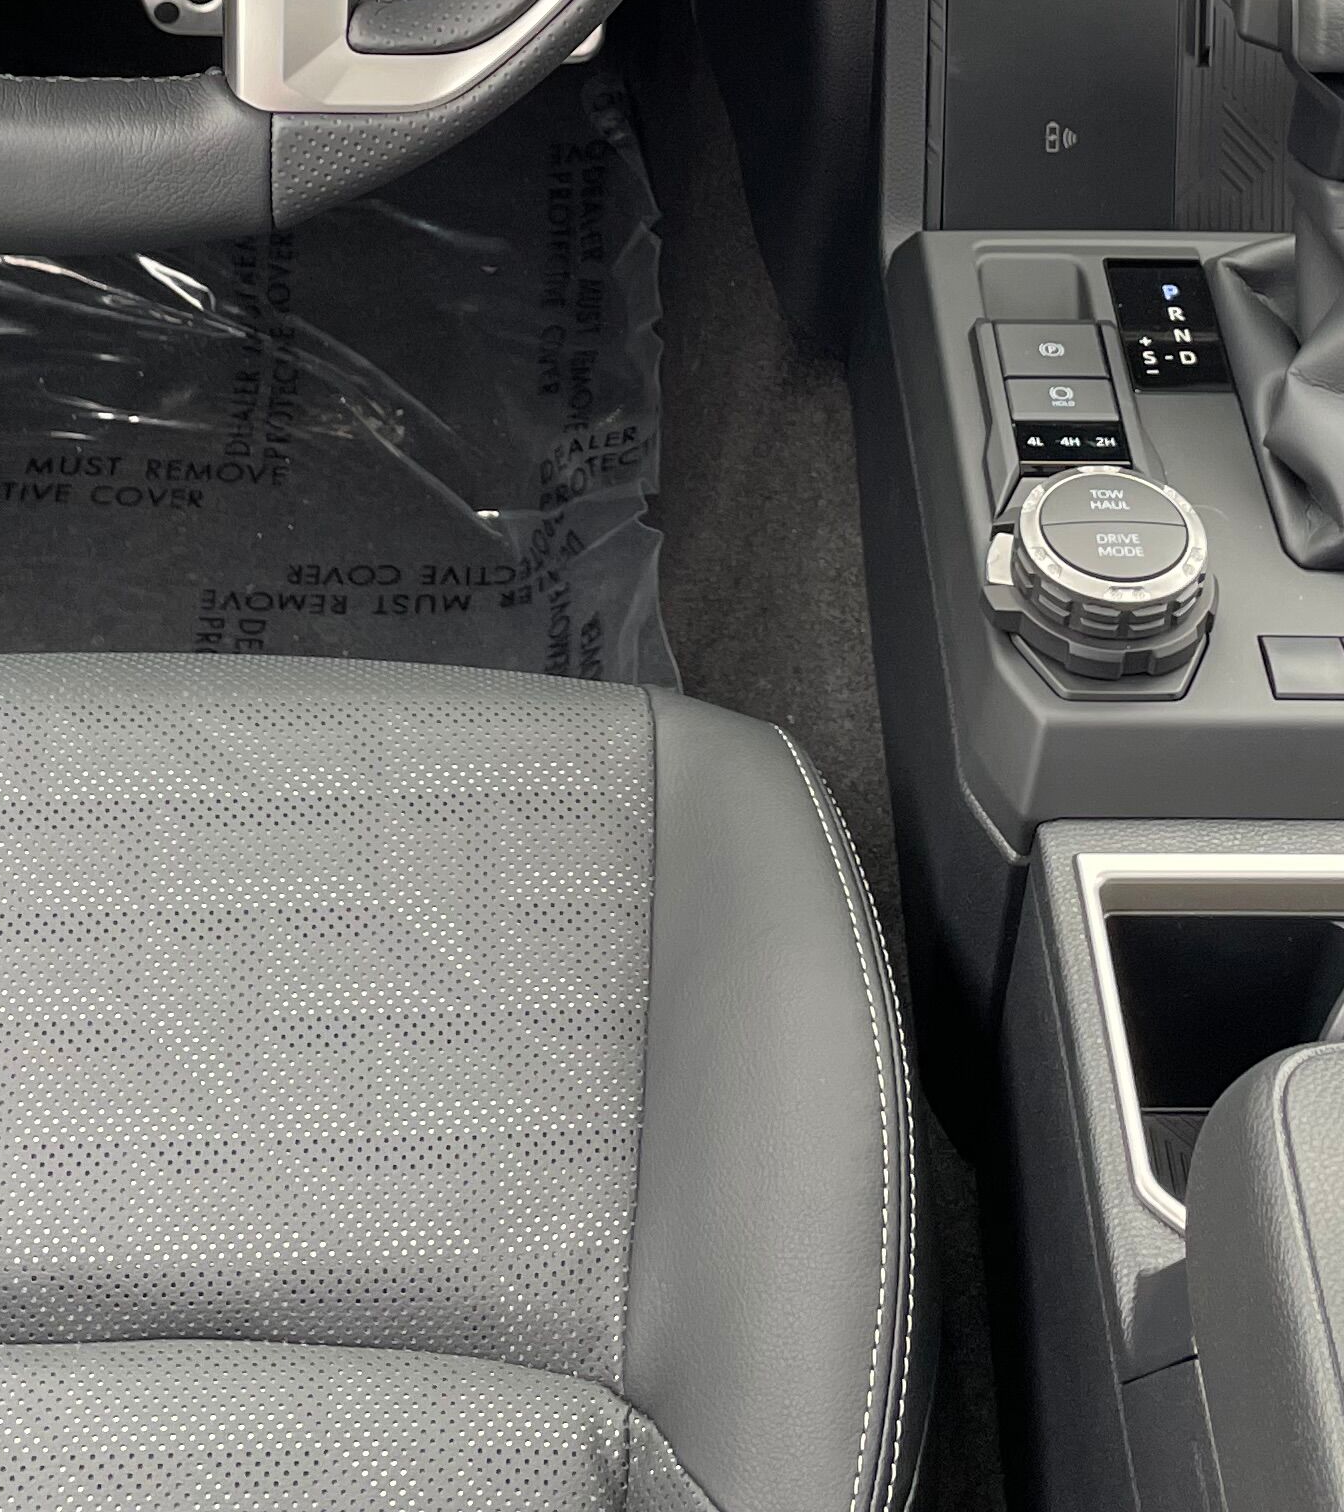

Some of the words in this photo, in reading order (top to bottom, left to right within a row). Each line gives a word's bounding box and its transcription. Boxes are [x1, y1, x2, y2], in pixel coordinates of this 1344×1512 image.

[1162, 284, 1179, 301] P
[1167, 306, 1186, 322] R
[1173, 328, 1192, 343] N
[1142, 350, 1157, 365] S
[1179, 350, 1197, 365] D
[1027, 436, 1045, 447] 4L
[1060, 436, 1081, 447] 4H
[1095, 436, 1116, 447] 2H
[24, 456, 124, 478] MUST
[144, 458, 291, 487] REMOVE
[90, 485, 205, 510] COVER
[1089, 489, 1124, 499] TOW
[1090, 500, 1130, 511] HAUL
[1096, 533, 1140, 544] DRIVE
[1098, 546, 1144, 557] MODE
[285, 564, 403, 586] COVER
[202, 588, 348, 618] REMOVE
[372, 592, 473, 616] MUST
